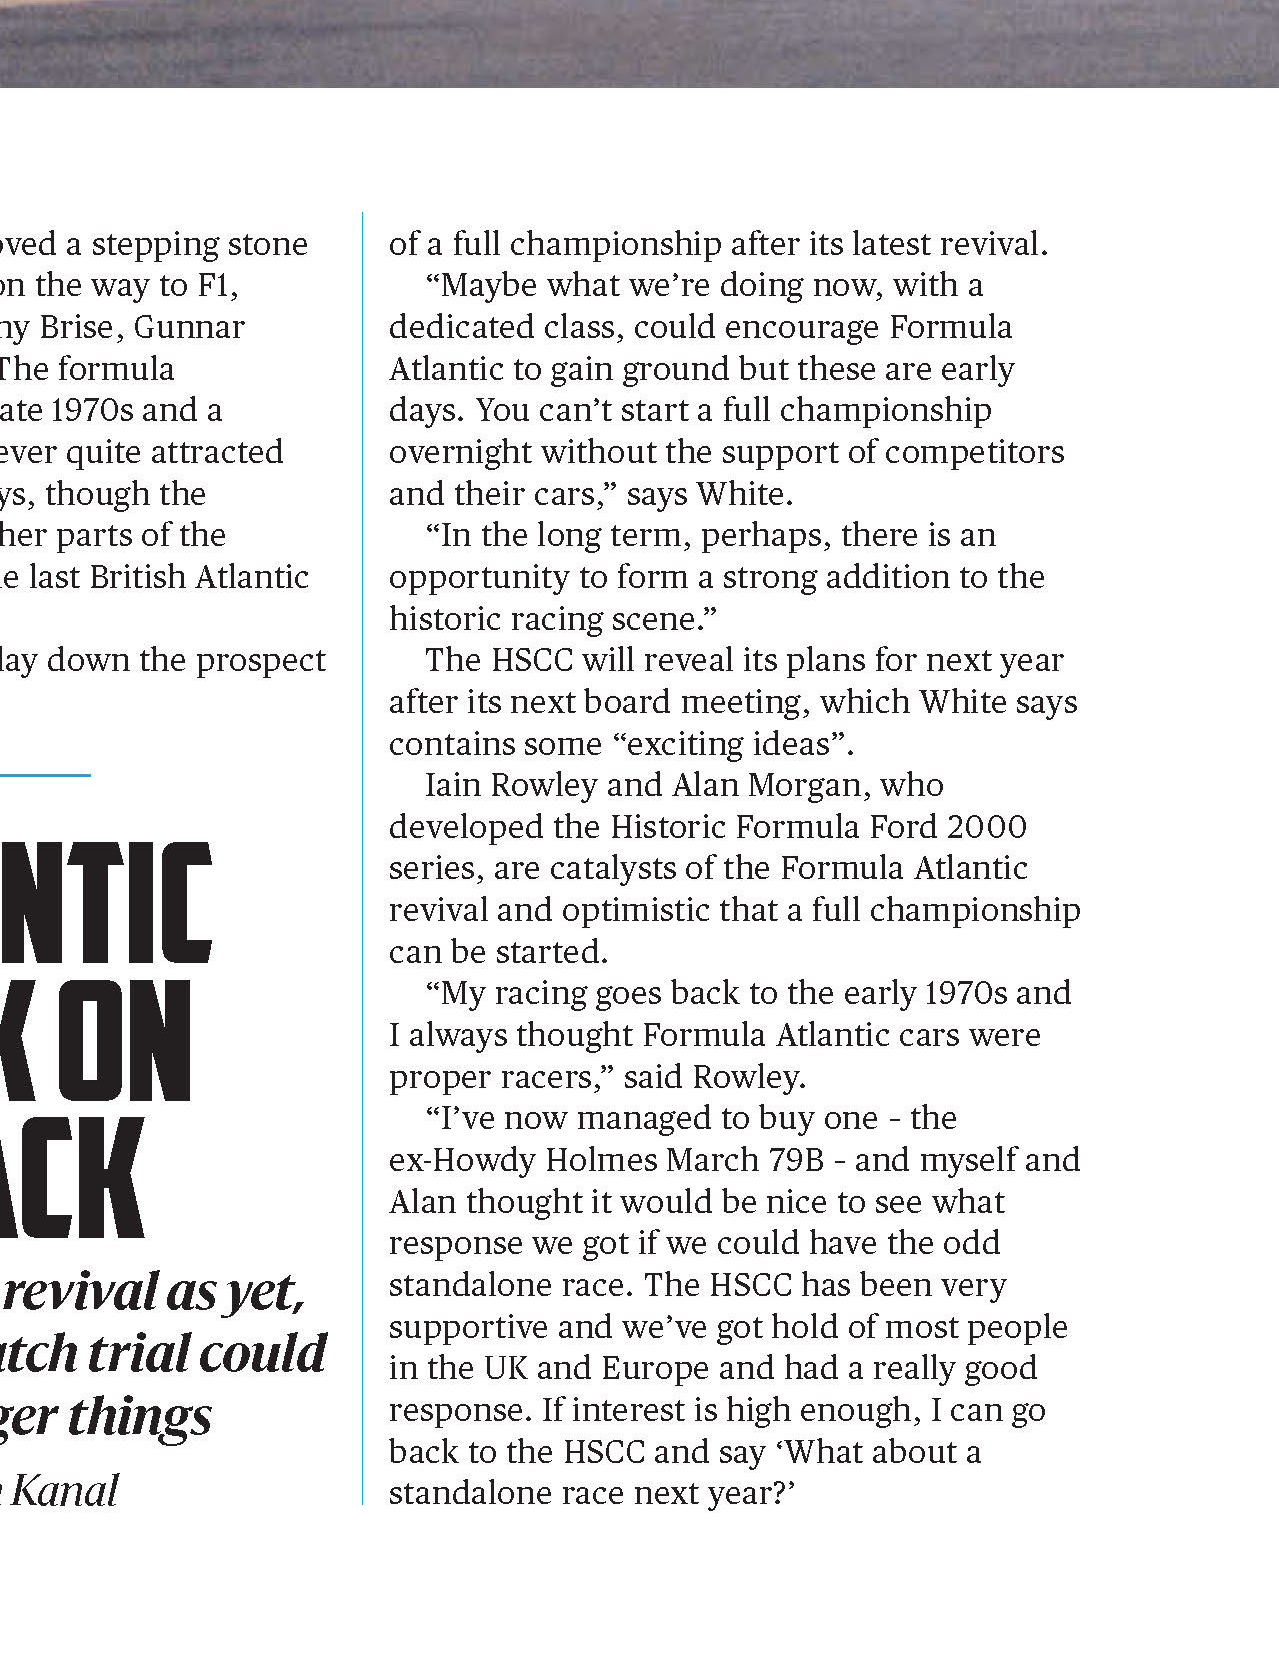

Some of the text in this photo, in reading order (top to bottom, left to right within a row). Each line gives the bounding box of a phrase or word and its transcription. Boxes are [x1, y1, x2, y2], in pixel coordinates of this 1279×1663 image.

[67, 238, 81, 255] a
[93, 231, 220, 262] stepping
[229, 234, 307, 255] stone
[390, 230, 1047, 262] of a full championship after its latest revival.
[36, 271, 81, 296] the
[91, 279, 150, 303] way
[160, 275, 187, 296] to
[199, 273, 237, 301] F1,
[41, 314, 123, 343] Brise,
[135, 315, 245, 338] Gunnar
[59, 355, 174, 380] formula
[390, 605, 716, 637] historic racing scene.”
[48, 646, 130, 671] down
[140, 646, 185, 671] the
[197, 650, 326, 678] prospect
[59, 980, 190, 1101] ON
[390, 1063, 805, 1095] proper racers,” said Rowley.
[3, 1270, 160, 1310] revival
[167, 1281, 217, 1310] as
[221, 1275, 304, 1318] yet,
[89, 1332, 192, 1372] trial
[200, 1332, 328, 1372] could
[69, 1395, 212, 1446] things
[10, 1473, 120, 1506] Kanal
[390, 1479, 794, 1511] standalone race next year?’
